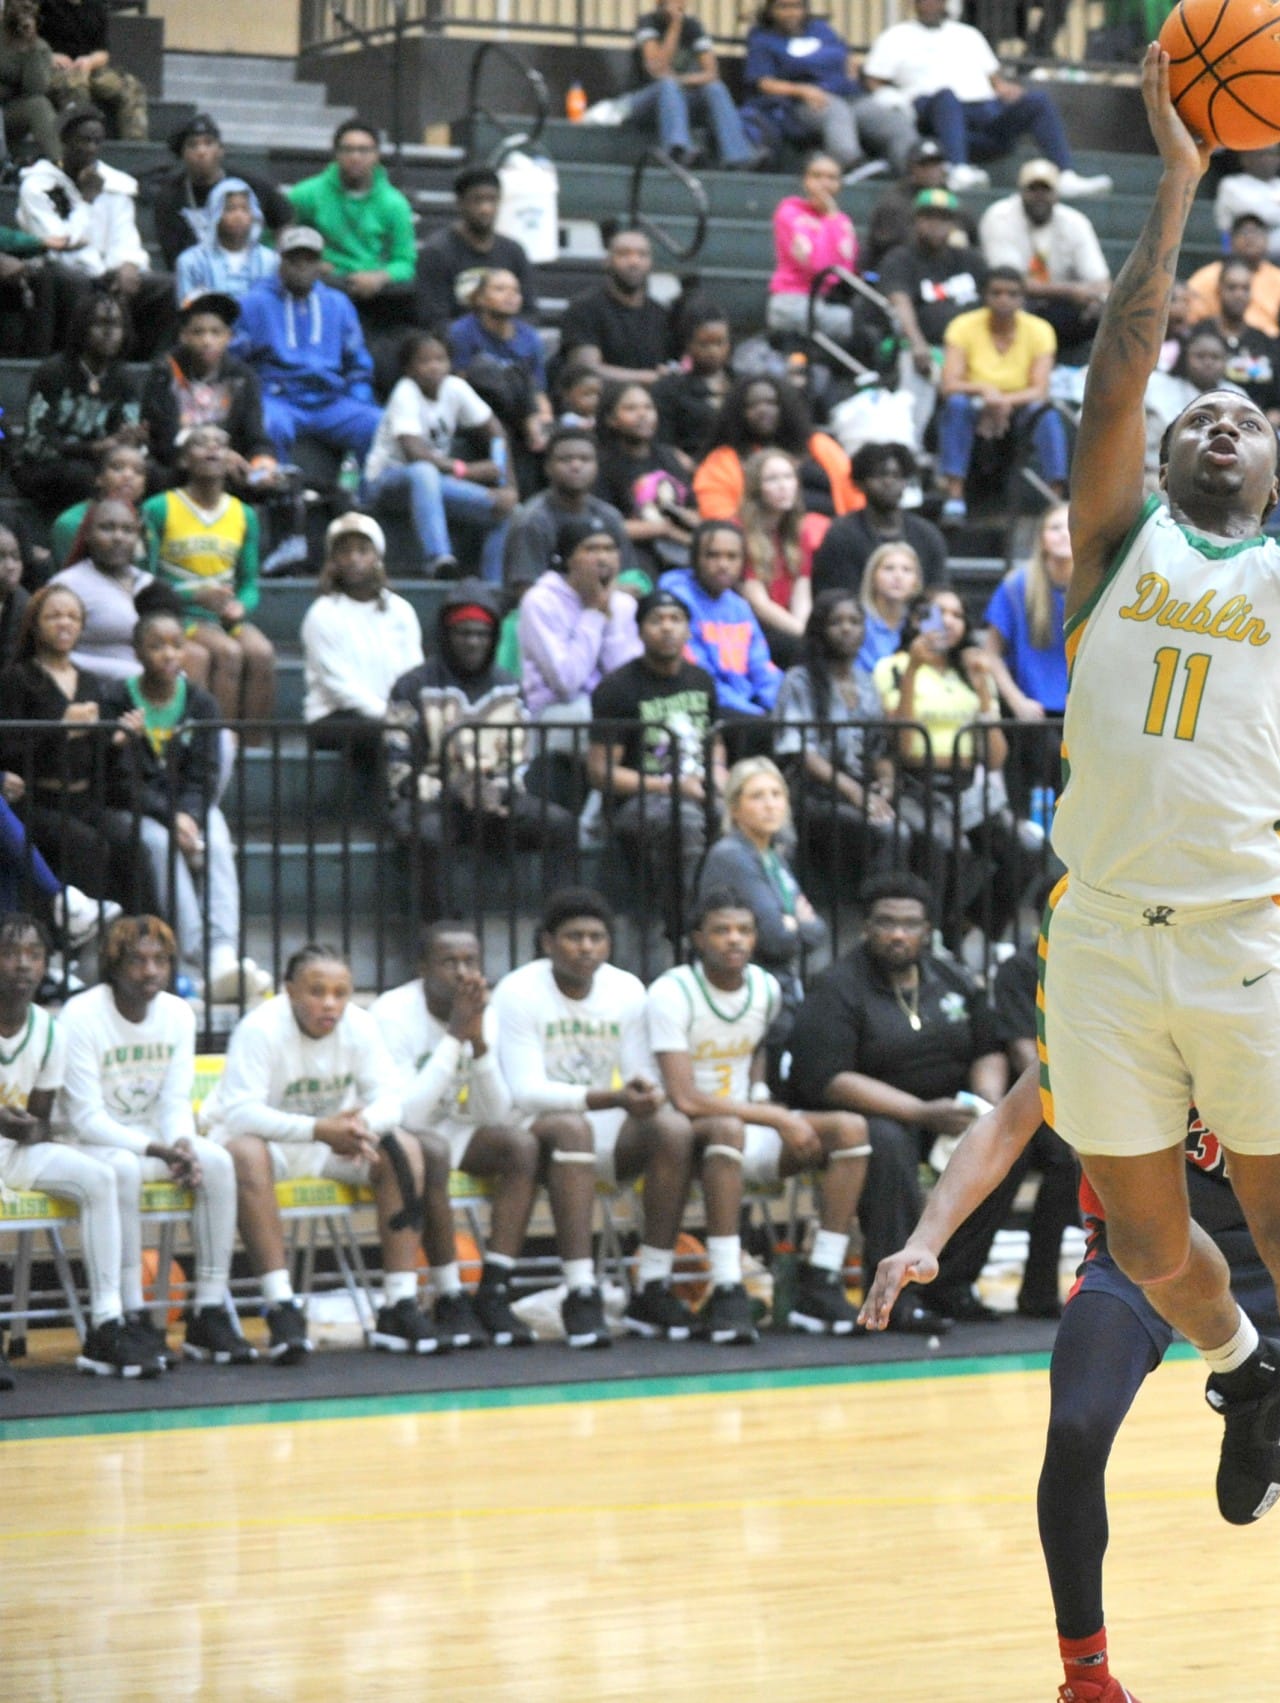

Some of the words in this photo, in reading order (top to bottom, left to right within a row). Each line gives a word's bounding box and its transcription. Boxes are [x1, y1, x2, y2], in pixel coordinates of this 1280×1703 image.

[1119, 572, 1271, 646] Dublin
[1143, 646, 1212, 742] 11
[713, 1065, 732, 1098] 3
